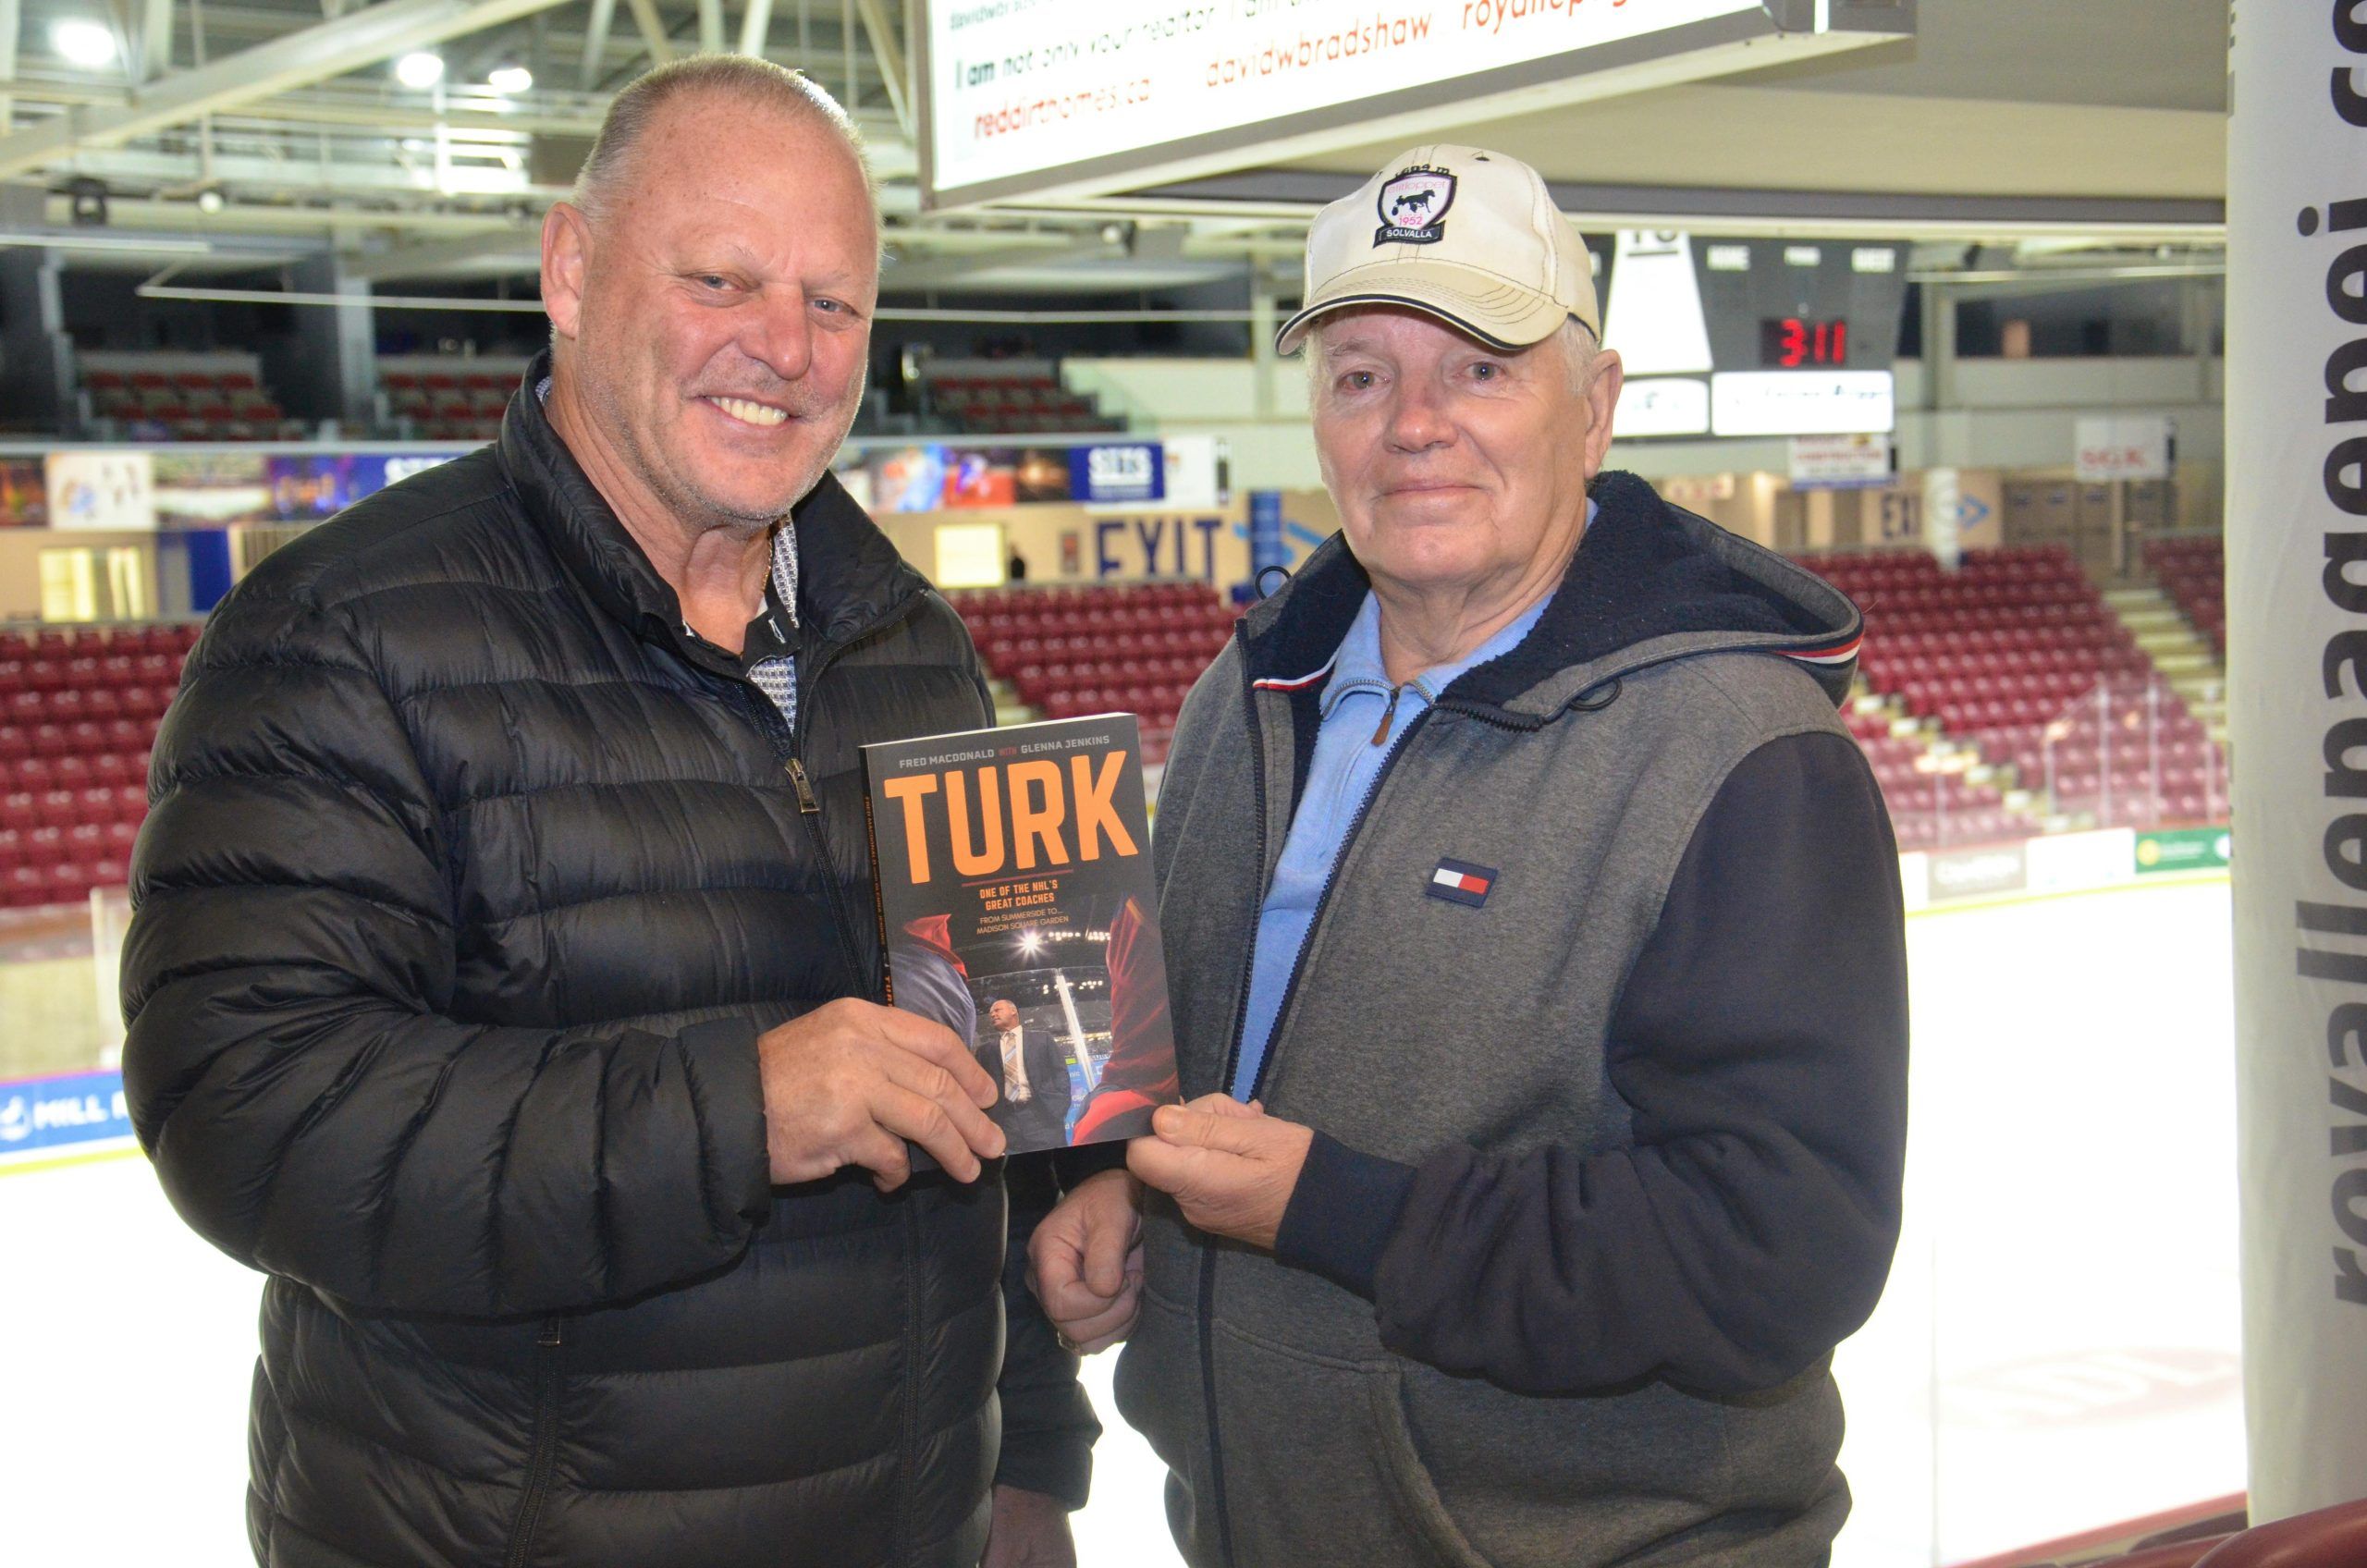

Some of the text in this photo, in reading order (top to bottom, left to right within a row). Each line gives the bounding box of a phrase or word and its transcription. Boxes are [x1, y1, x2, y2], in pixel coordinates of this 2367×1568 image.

[1206, 13, 1432, 88] davidwbradshaw
[967, 61, 995, 86] am
[1003, 50, 1034, 76] not
[1398, 215, 1424, 227] 1952
[1386, 228, 1433, 239] SOLVALLA
[900, 735, 1110, 769] FRED MACDONALD WITH GLENNA JENKINS
[884, 750, 1139, 885] TURK
[980, 879, 1059, 899] ONE OF THE NHL'S
[985, 892, 1055, 911] GREAT COACHES
[976, 915, 1070, 935] MADISON SQUARE GARDEN
[980, 916, 1000, 925] FROM
[1001, 911, 1047, 922] SUMMERSIDE
